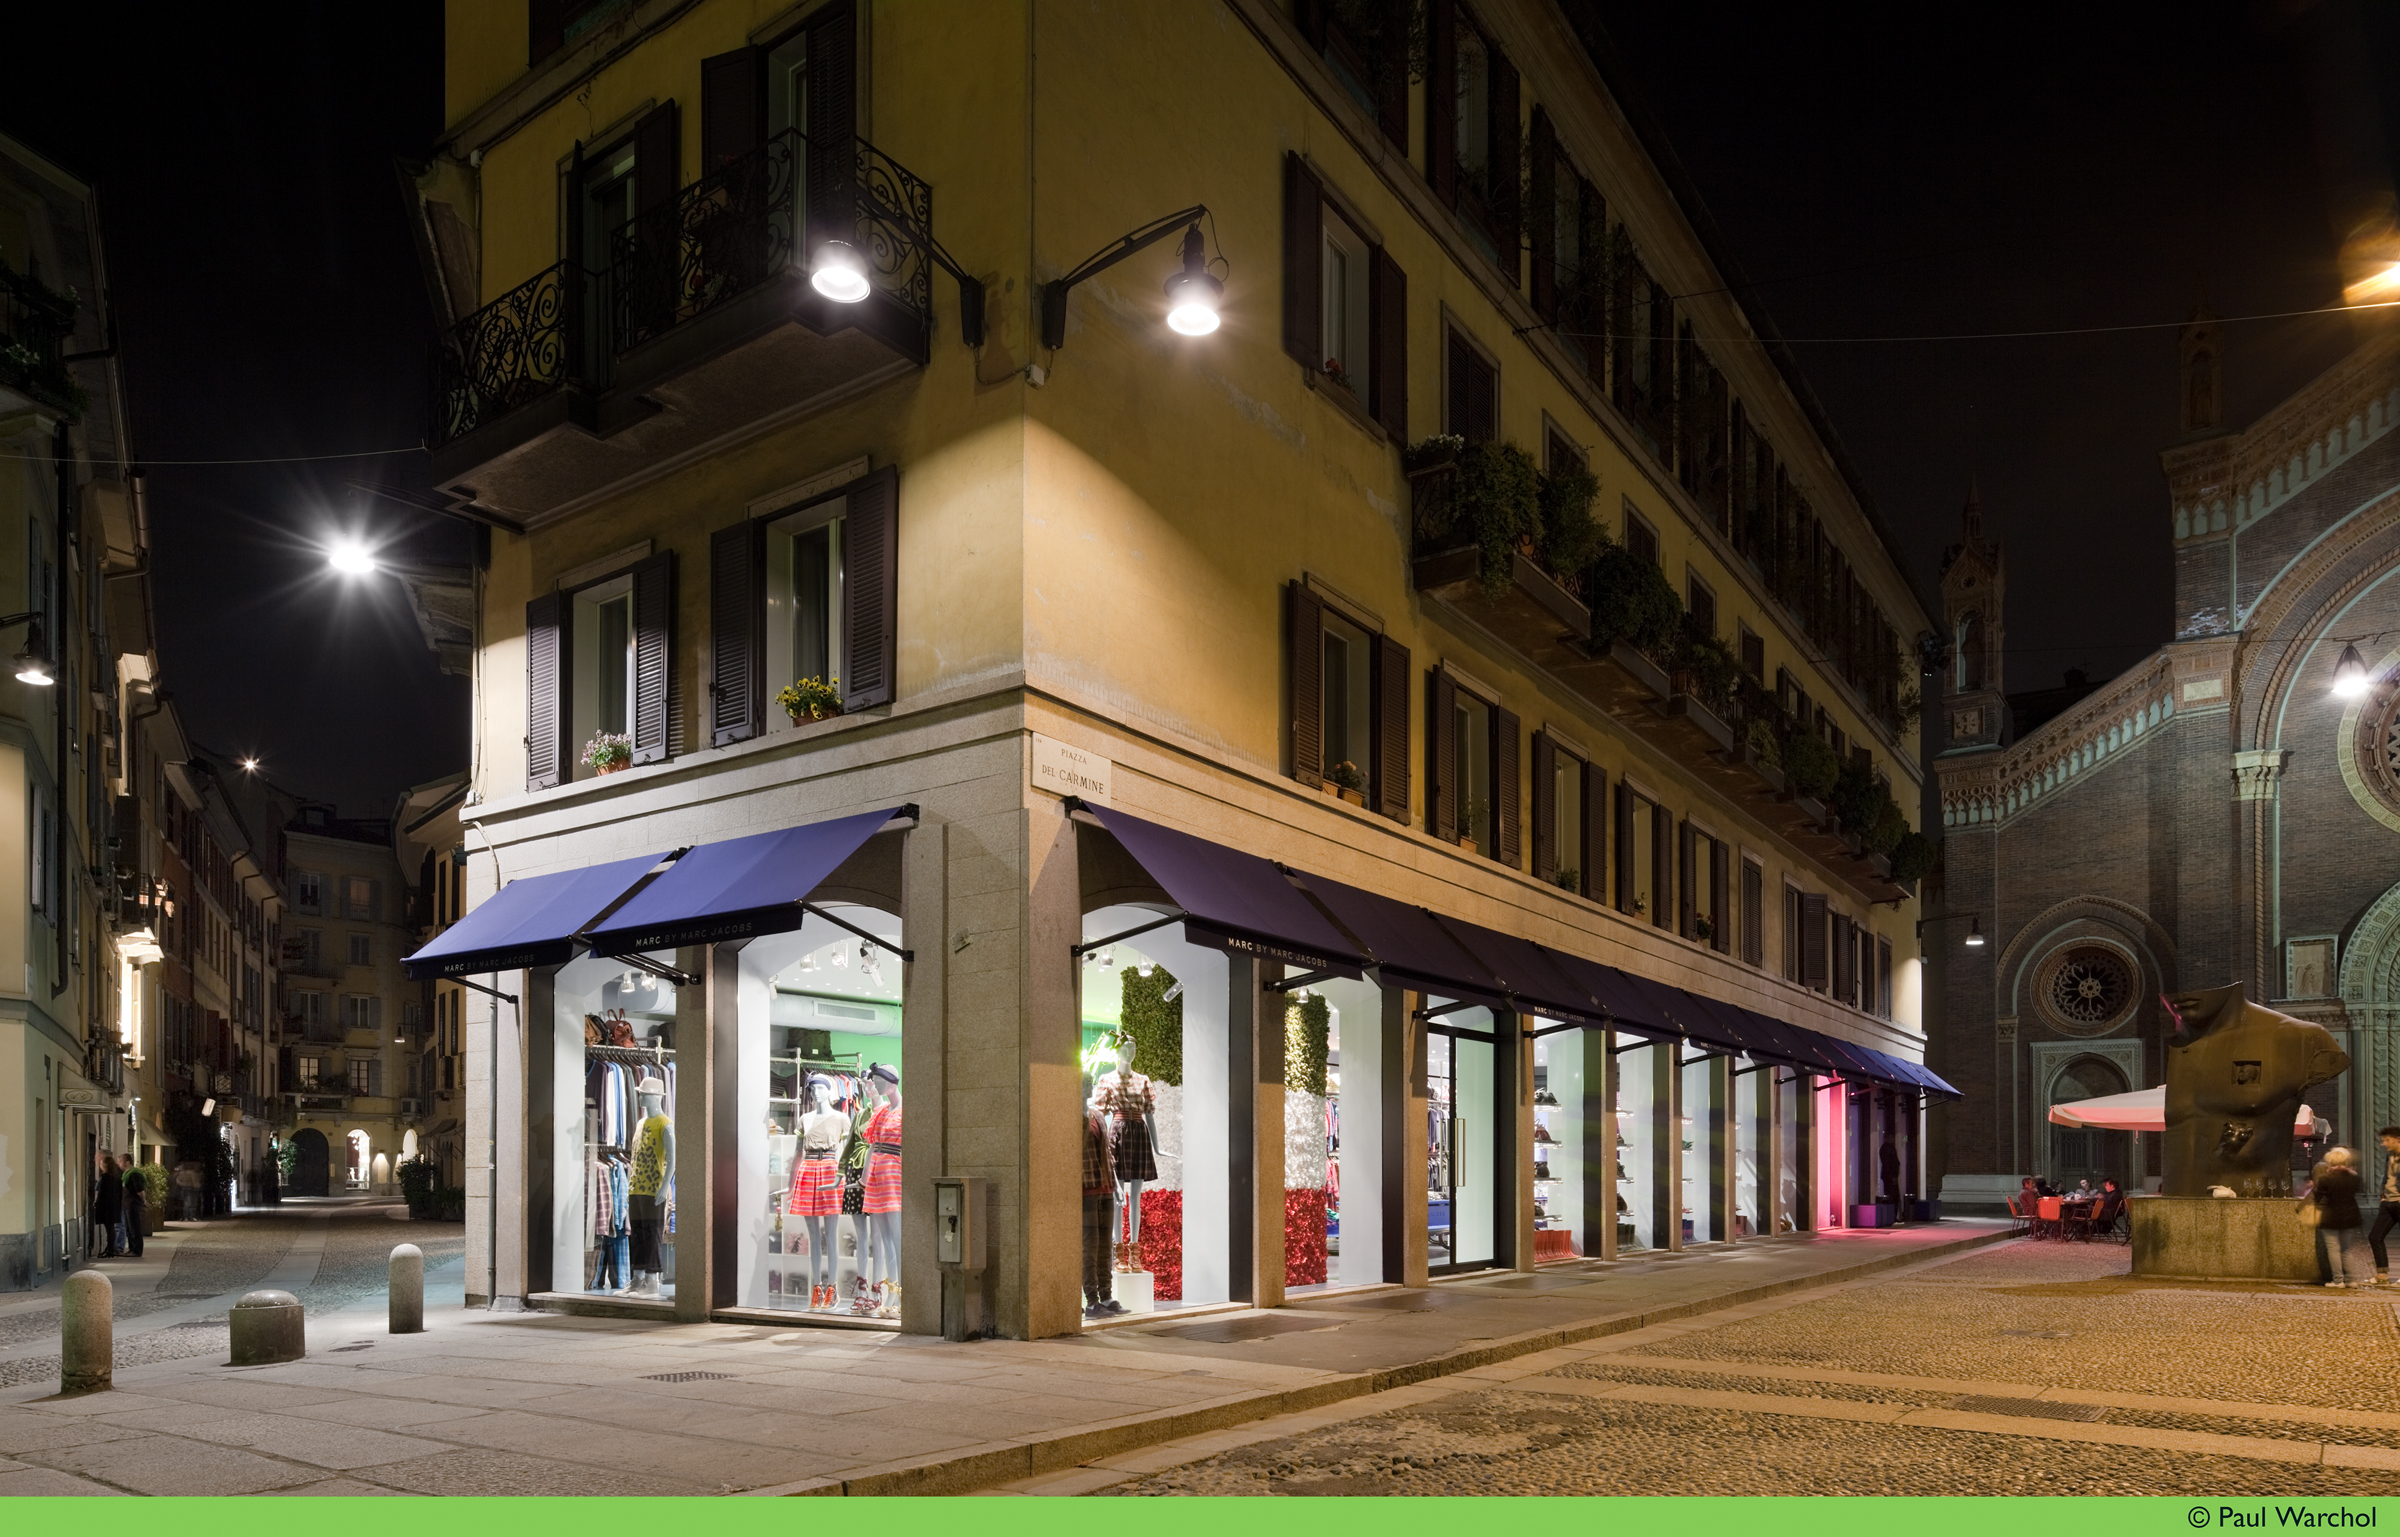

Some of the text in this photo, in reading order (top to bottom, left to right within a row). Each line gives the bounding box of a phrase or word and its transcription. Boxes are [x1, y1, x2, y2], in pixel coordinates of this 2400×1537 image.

[1061, 748, 1087, 765] PIAZZA
[1042, 764, 1104, 795] DEL CARMINE
[635, 922, 753, 947] MARC BY MARC JACOBS
[444, 954, 534, 973] MARC BY MARC JACOBS
[1228, 937, 1328, 968] MARC BY MARC JACOBS
[1534, 1006, 1547, 1015] MARC
